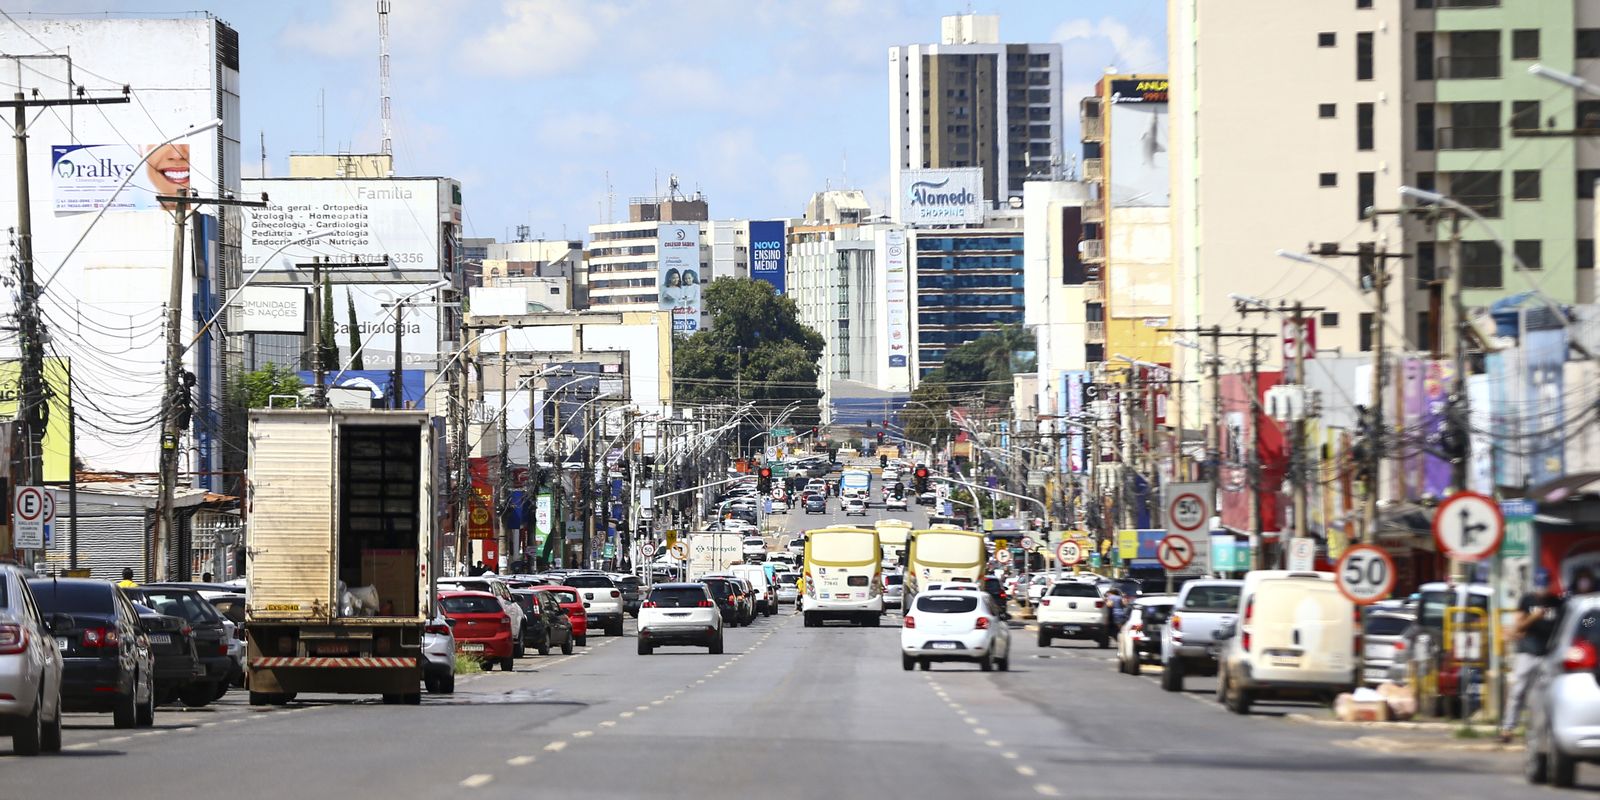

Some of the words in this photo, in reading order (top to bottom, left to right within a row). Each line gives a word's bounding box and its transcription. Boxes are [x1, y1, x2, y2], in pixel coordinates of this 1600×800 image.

[357, 187, 413, 200] Família
[911, 187, 974, 206] Alameda
[287, 204, 311, 213] geral
[322, 204, 368, 212] Ortopedia
[920, 208, 964, 217] SHOPPING
[251, 213, 293, 221] Urologia
[309, 213, 368, 221] Homeopatia
[251, 221, 306, 230] Ginecologia
[316, 221, 368, 229] Cardiologia
[329, 239, 369, 247] Nutrição
[754, 241, 780, 249] NOVO
[754, 250, 781, 260] ENSINO
[236, 301, 297, 309] OMUNIDADE
[258, 308, 297, 318] NAÇÕES
[25, 495, 34, 513] E
[1179, 501, 1197, 514] 50
[1062, 546, 1076, 556] 50
[1346, 555, 1386, 585] 50
